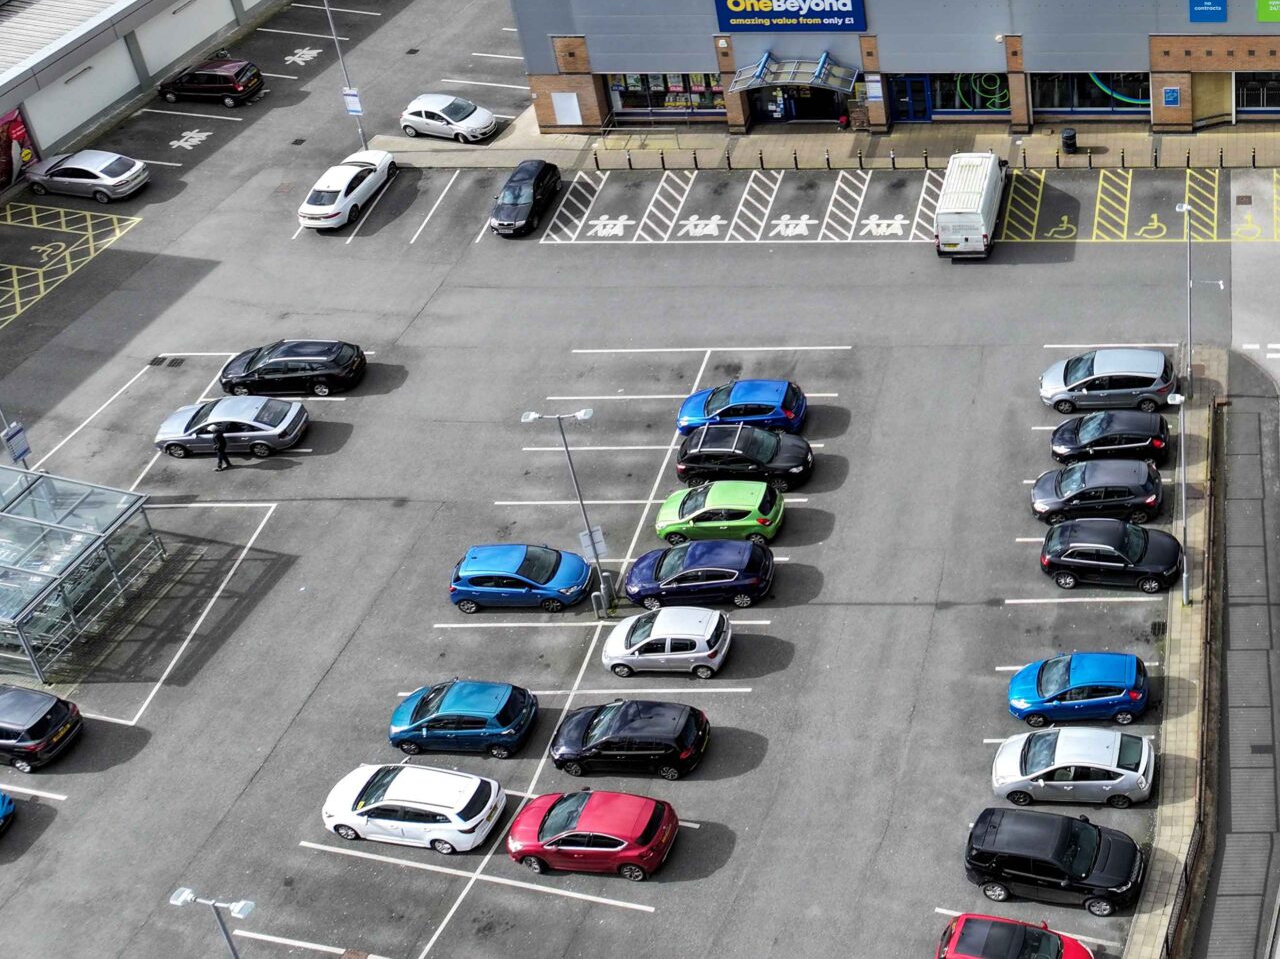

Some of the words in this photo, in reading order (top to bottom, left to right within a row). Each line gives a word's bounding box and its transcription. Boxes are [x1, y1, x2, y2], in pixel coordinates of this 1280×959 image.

[729, 17, 770, 26] amazing
[772, 17, 798, 25] value
[799, 17, 822, 25] from
[823, 16, 843, 26] only
